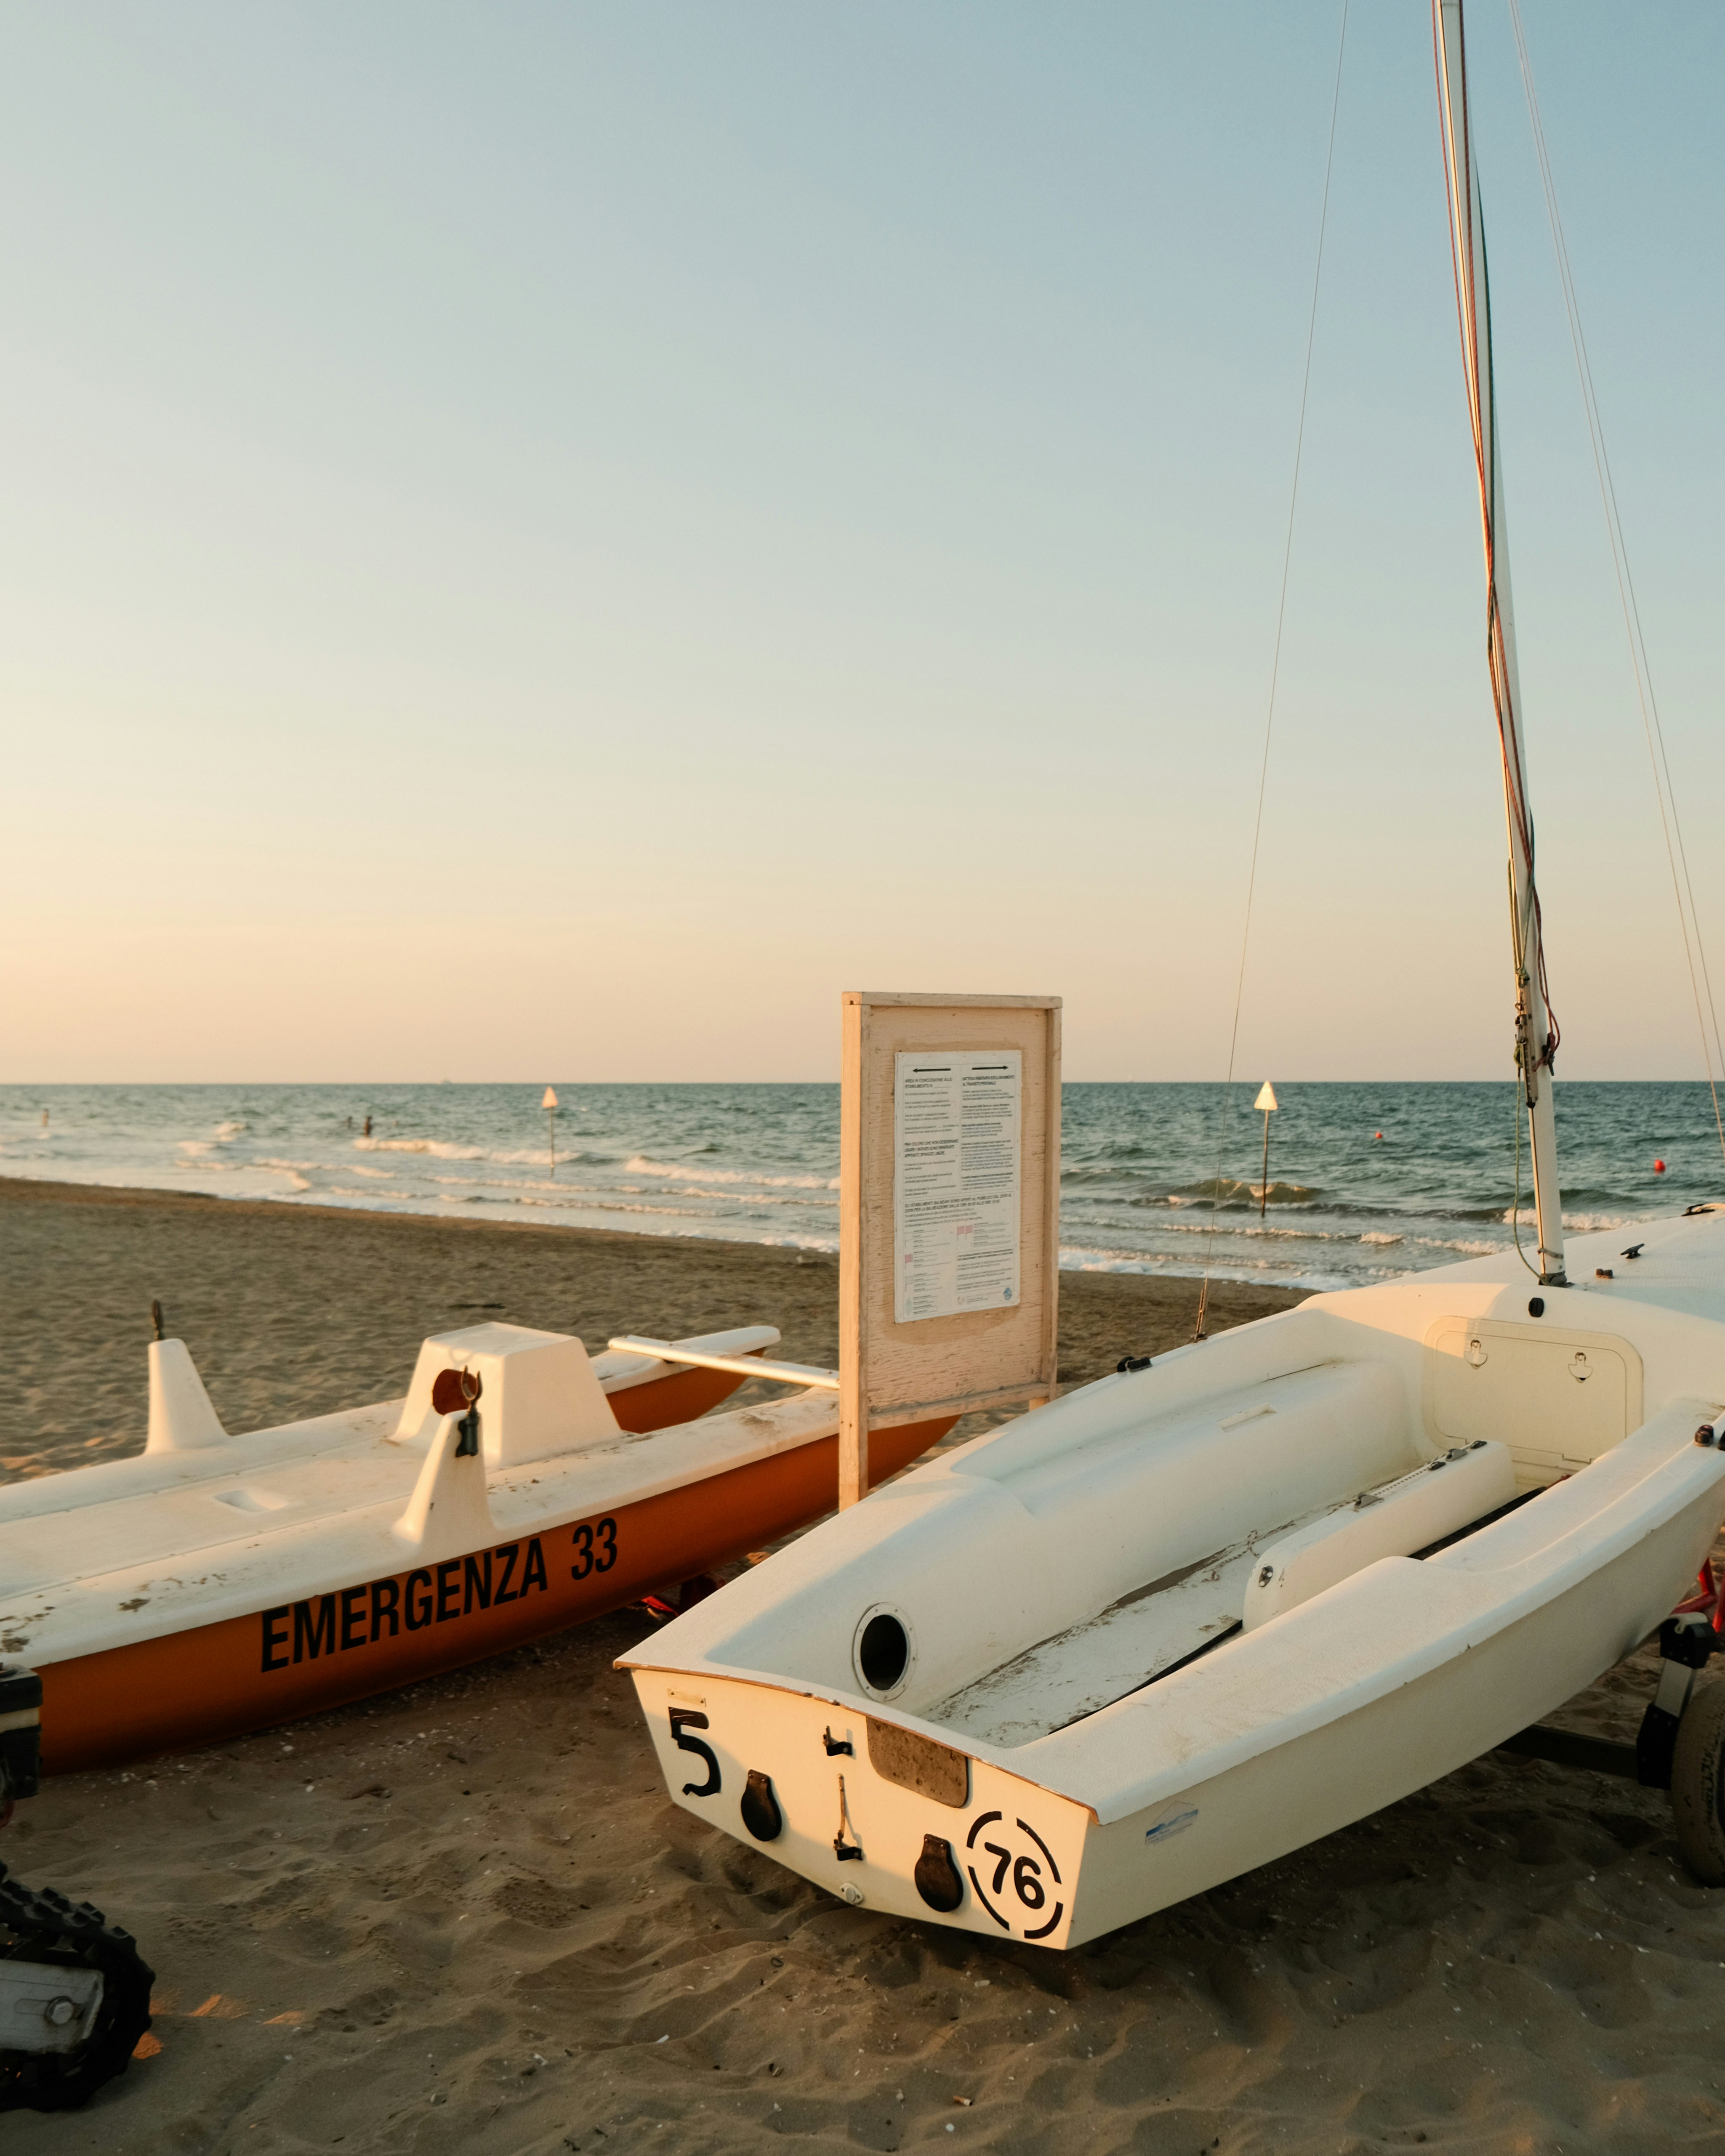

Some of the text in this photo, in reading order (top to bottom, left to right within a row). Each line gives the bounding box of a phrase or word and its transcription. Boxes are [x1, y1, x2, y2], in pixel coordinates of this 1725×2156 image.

[261, 1518, 617, 1673] EMERGENZA 33
[668, 1707, 721, 1797] 5
[984, 1841, 1045, 1910] 76
